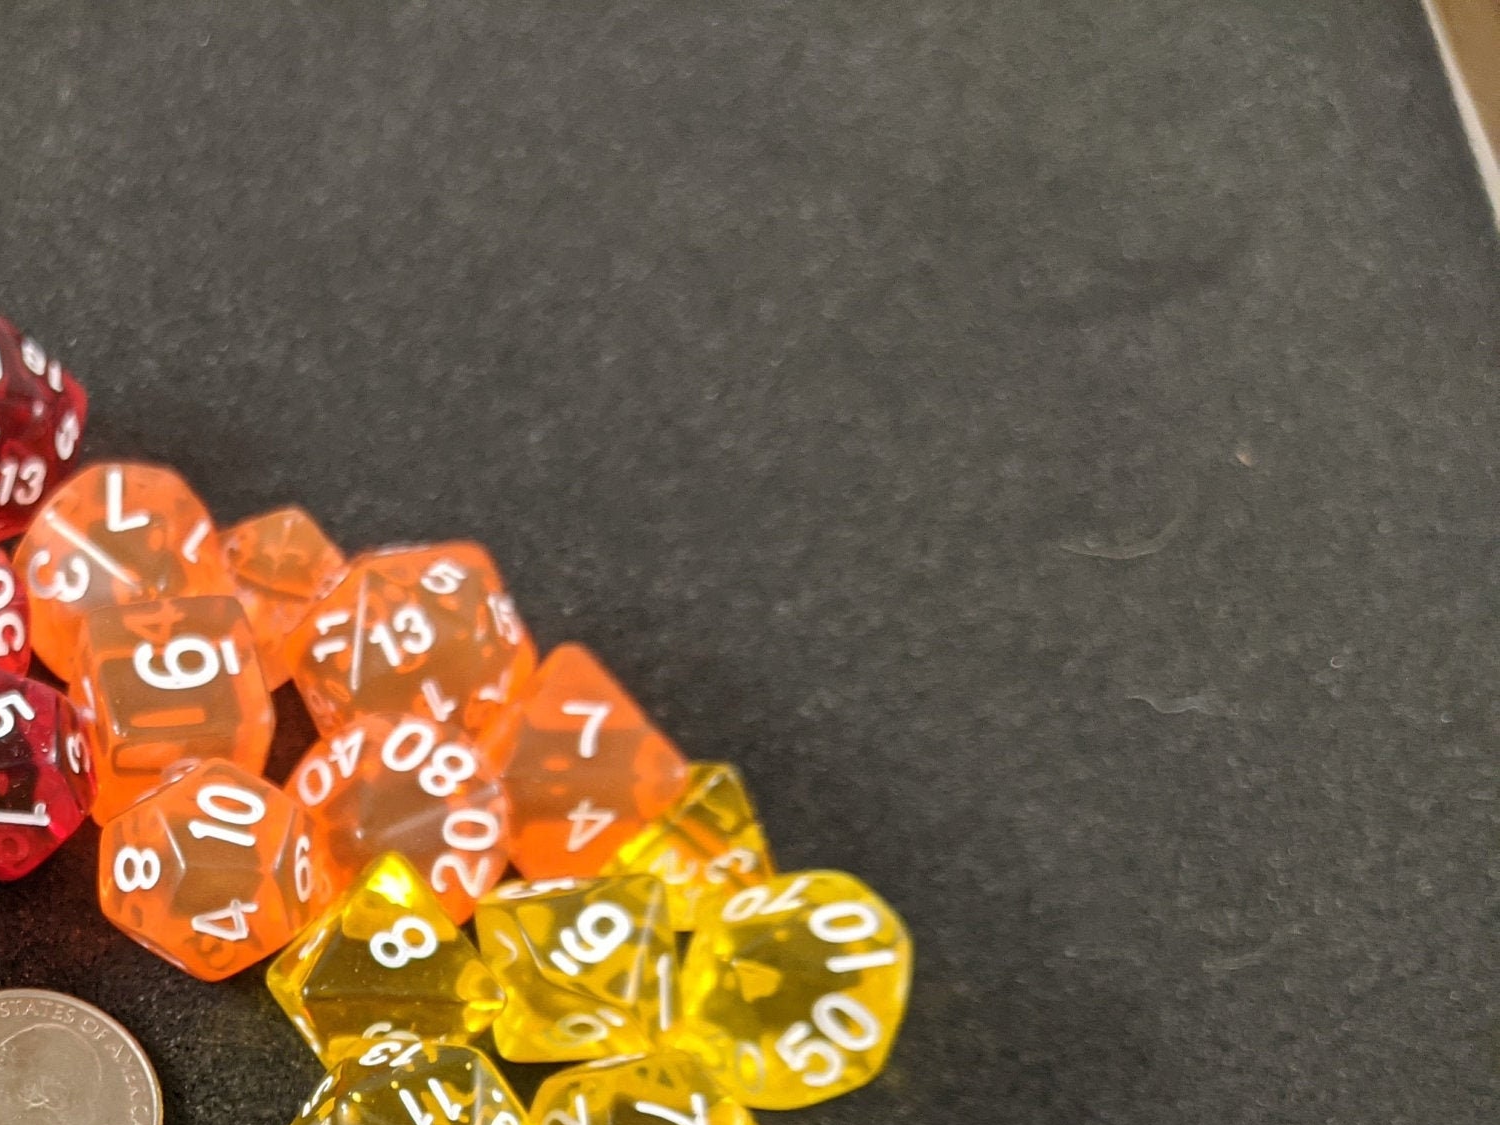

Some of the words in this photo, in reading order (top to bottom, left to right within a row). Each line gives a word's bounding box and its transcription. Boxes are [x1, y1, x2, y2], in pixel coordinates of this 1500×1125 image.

[107, 468, 150, 532] 7
[27, 549, 91, 603] 3
[420, 560, 467, 595] 5
[311, 611, 348, 664] 11
[369, 605, 434, 667] 13
[380, 719, 478, 798] 80
[560, 702, 614, 759] 7
[297, 729, 365, 807] 40
[187, 783, 266, 847] 10
[566, 797, 616, 853] 4
[113, 844, 161, 893] 8
[430, 807, 500, 900] 20
[190, 899, 259, 941] 4
[722, 876, 812, 923] 70
[368, 915, 438, 969] 8
[808, 901, 893, 974] 10
[0, 1000, 77, 1024] STATES
[81, 1017, 110, 1041] OF
[773, 993, 878, 1087] 50
[358, 1040, 423, 1067] 13
